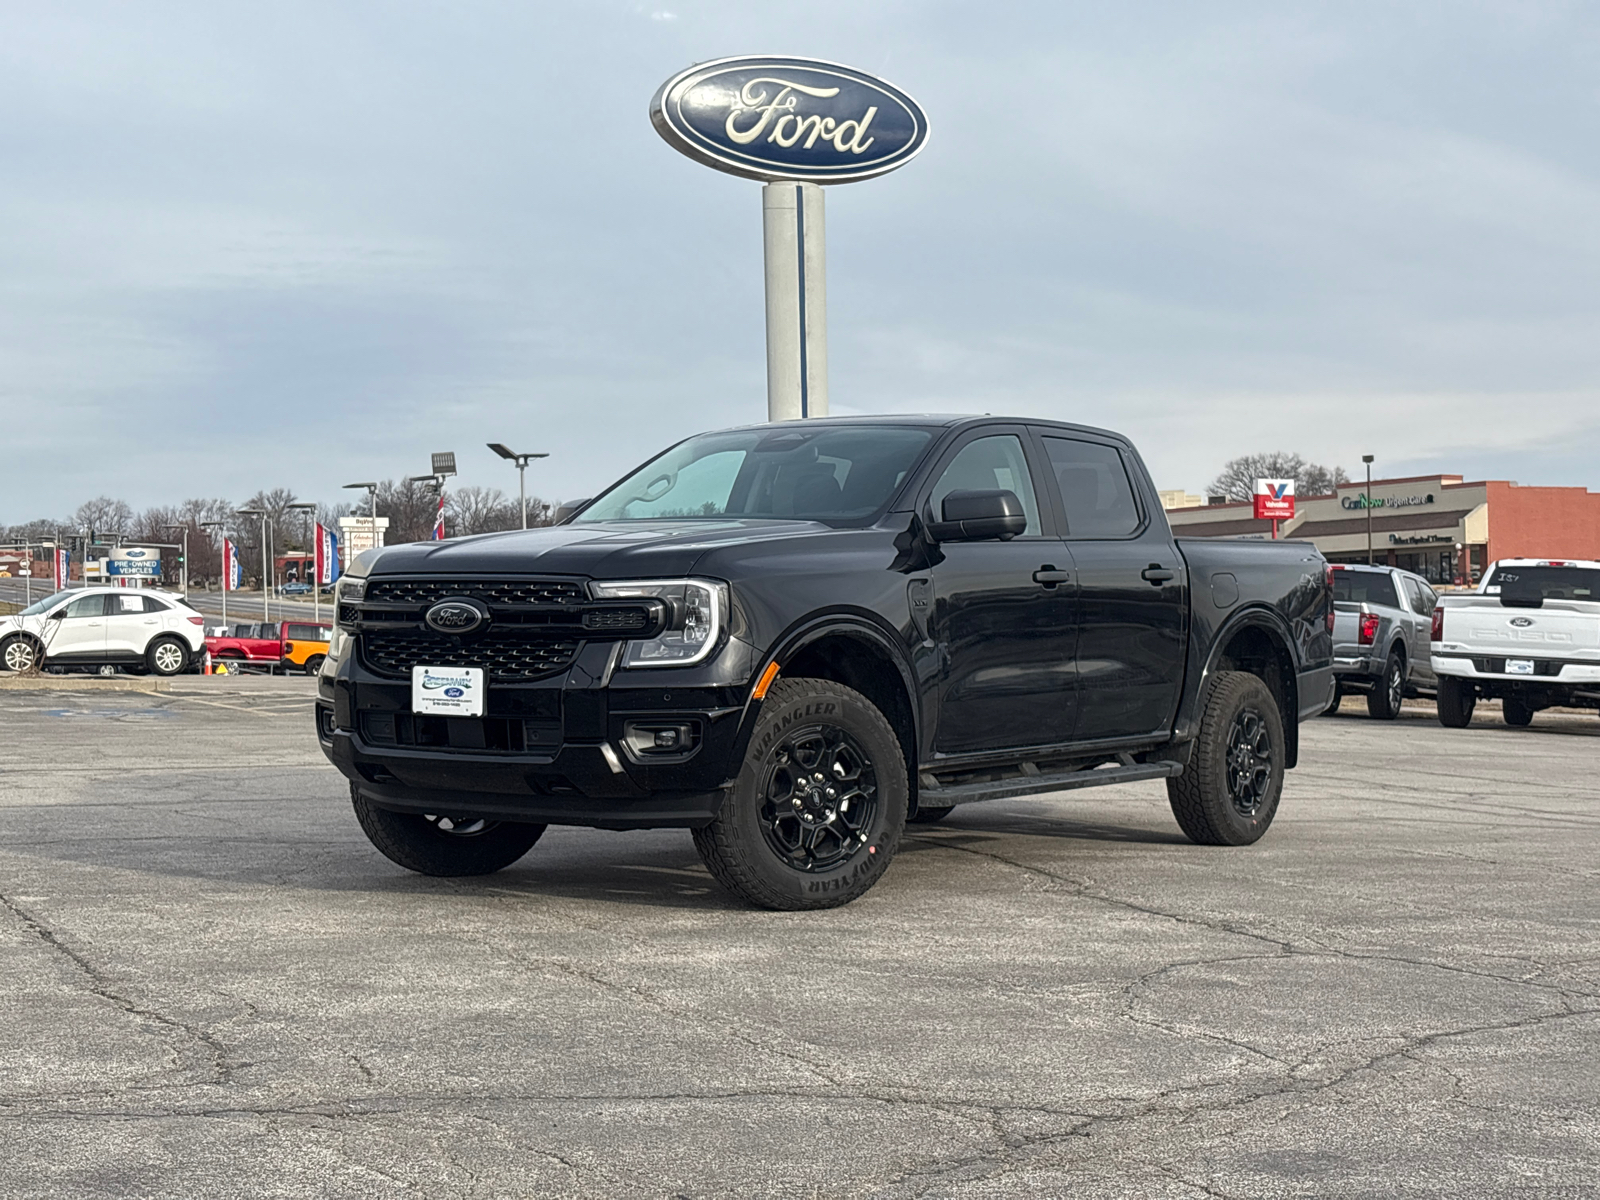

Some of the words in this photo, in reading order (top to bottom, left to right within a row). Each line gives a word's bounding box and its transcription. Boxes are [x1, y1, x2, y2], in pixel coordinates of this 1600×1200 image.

[725, 77, 878, 154] Ford
[1385, 497, 1409, 508] Urgent
[1409, 496, 1427, 506] Care
[437, 608, 468, 625] Ford
[1469, 628, 1572, 643] F-150
[752, 702, 837, 763] WRANGLER
[808, 831, 890, 893] GOODYEAR
